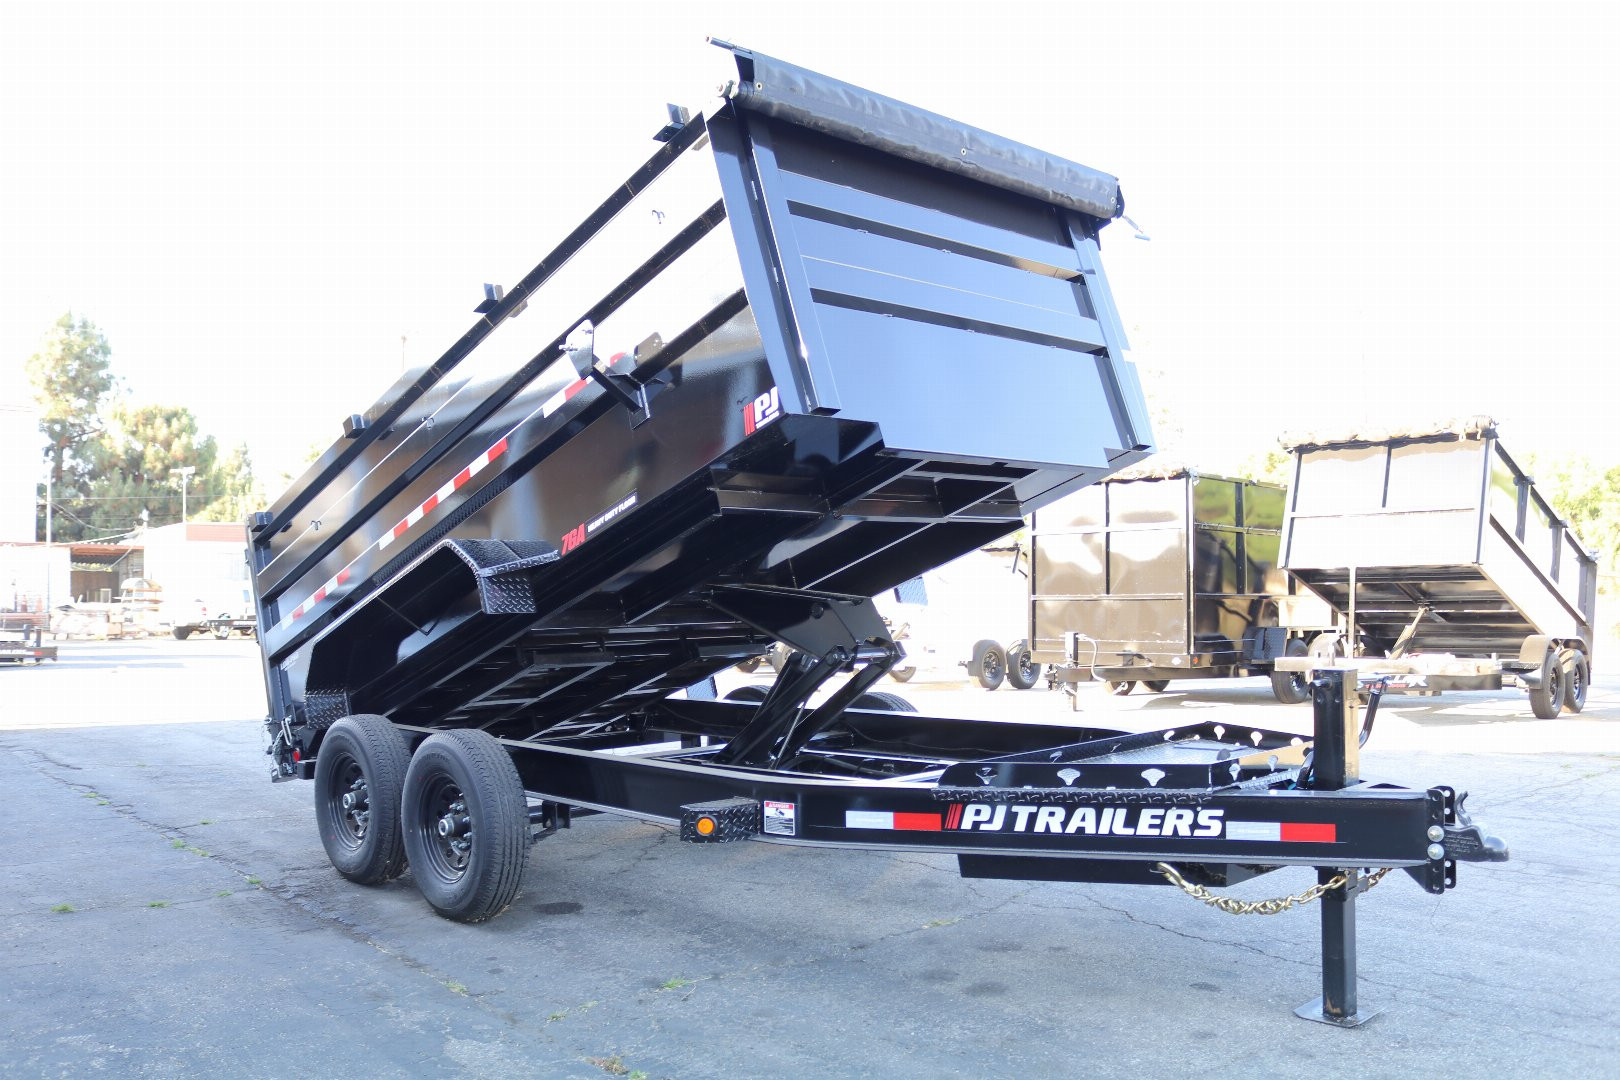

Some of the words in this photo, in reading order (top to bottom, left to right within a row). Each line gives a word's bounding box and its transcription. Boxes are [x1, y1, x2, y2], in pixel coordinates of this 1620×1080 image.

[754, 386, 779, 423] PJ
[960, 804, 1008, 831] PJ
[1010, 805, 1225, 838] TRAILERS
